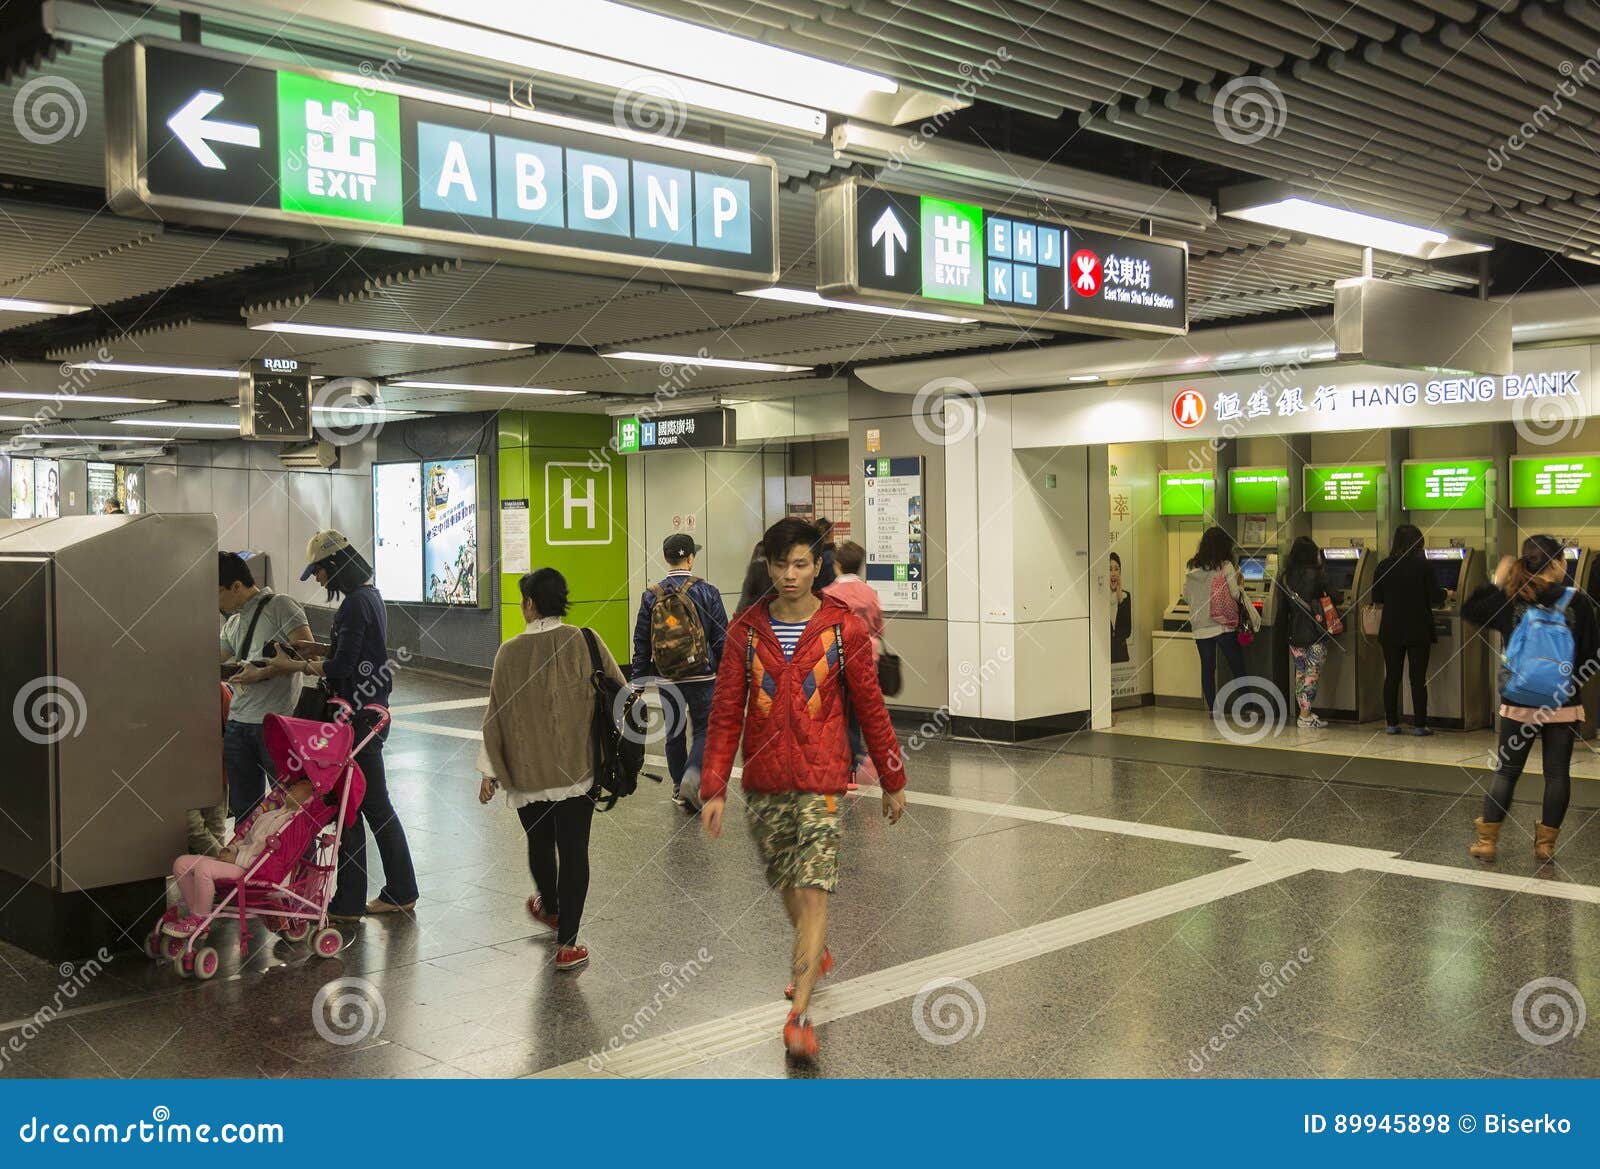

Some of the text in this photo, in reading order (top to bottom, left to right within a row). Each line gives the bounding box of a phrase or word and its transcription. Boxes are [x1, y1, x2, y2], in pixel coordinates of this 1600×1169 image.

[307, 167, 377, 202] EXIT
[436, 140, 738, 239] A B D N P
[994, 224, 1053, 260] E H J
[935, 264, 970, 287] EXIT
[994, 267, 1032, 298] K L
[1103, 254, 1151, 290] 尖東站
[1104, 286, 1174, 309] East Tsim Sha Tsui Station
[264, 358, 298, 370] RADO
[1214, 370, 1581, 421] 恒生銀行 HANG SENG BANK
[644, 426, 653, 442] H
[563, 478, 595, 529] H
